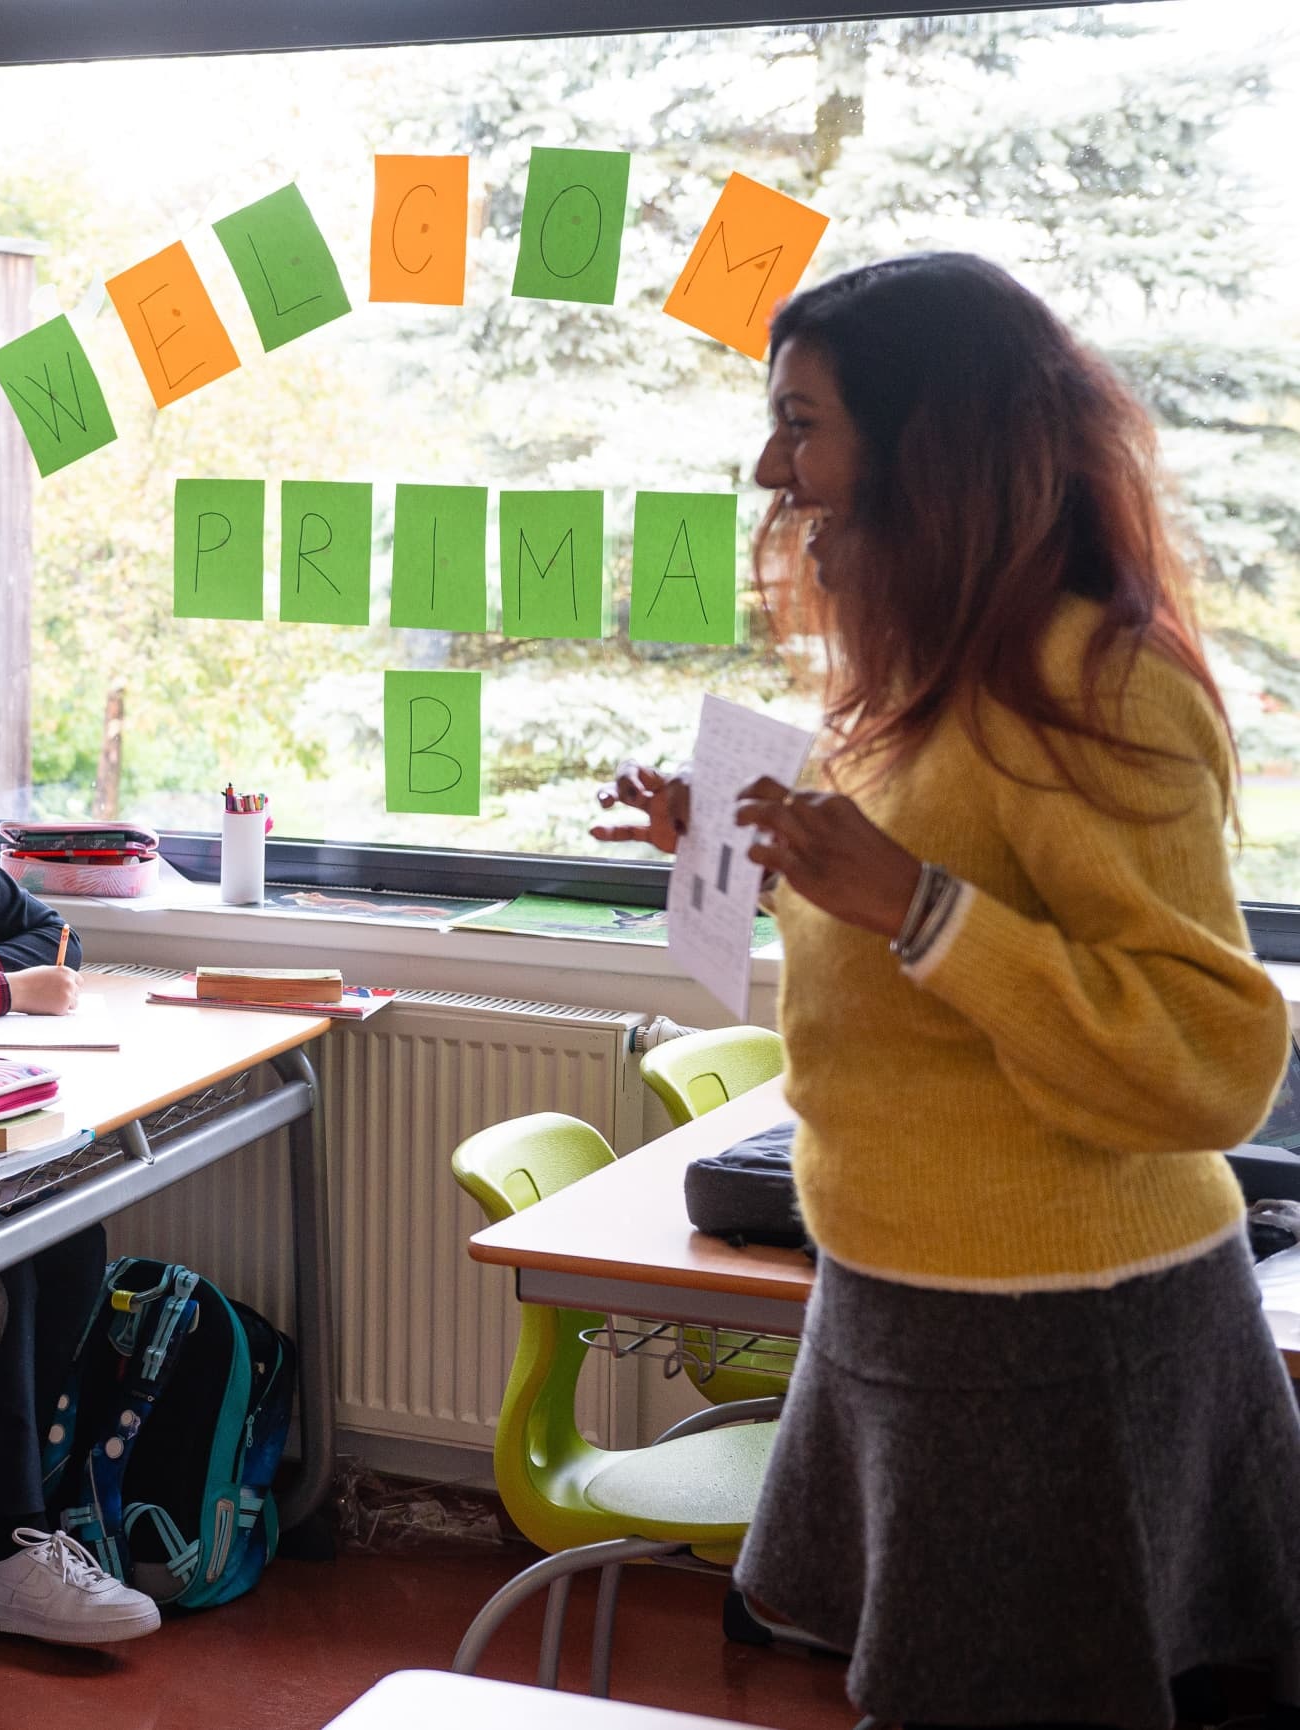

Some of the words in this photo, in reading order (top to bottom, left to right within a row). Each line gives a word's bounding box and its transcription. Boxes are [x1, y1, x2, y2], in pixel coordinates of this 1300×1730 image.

[7, 183, 784, 444] WELCOM
[194, 511, 709, 626] PRIMA
[408, 696, 463, 795] B
